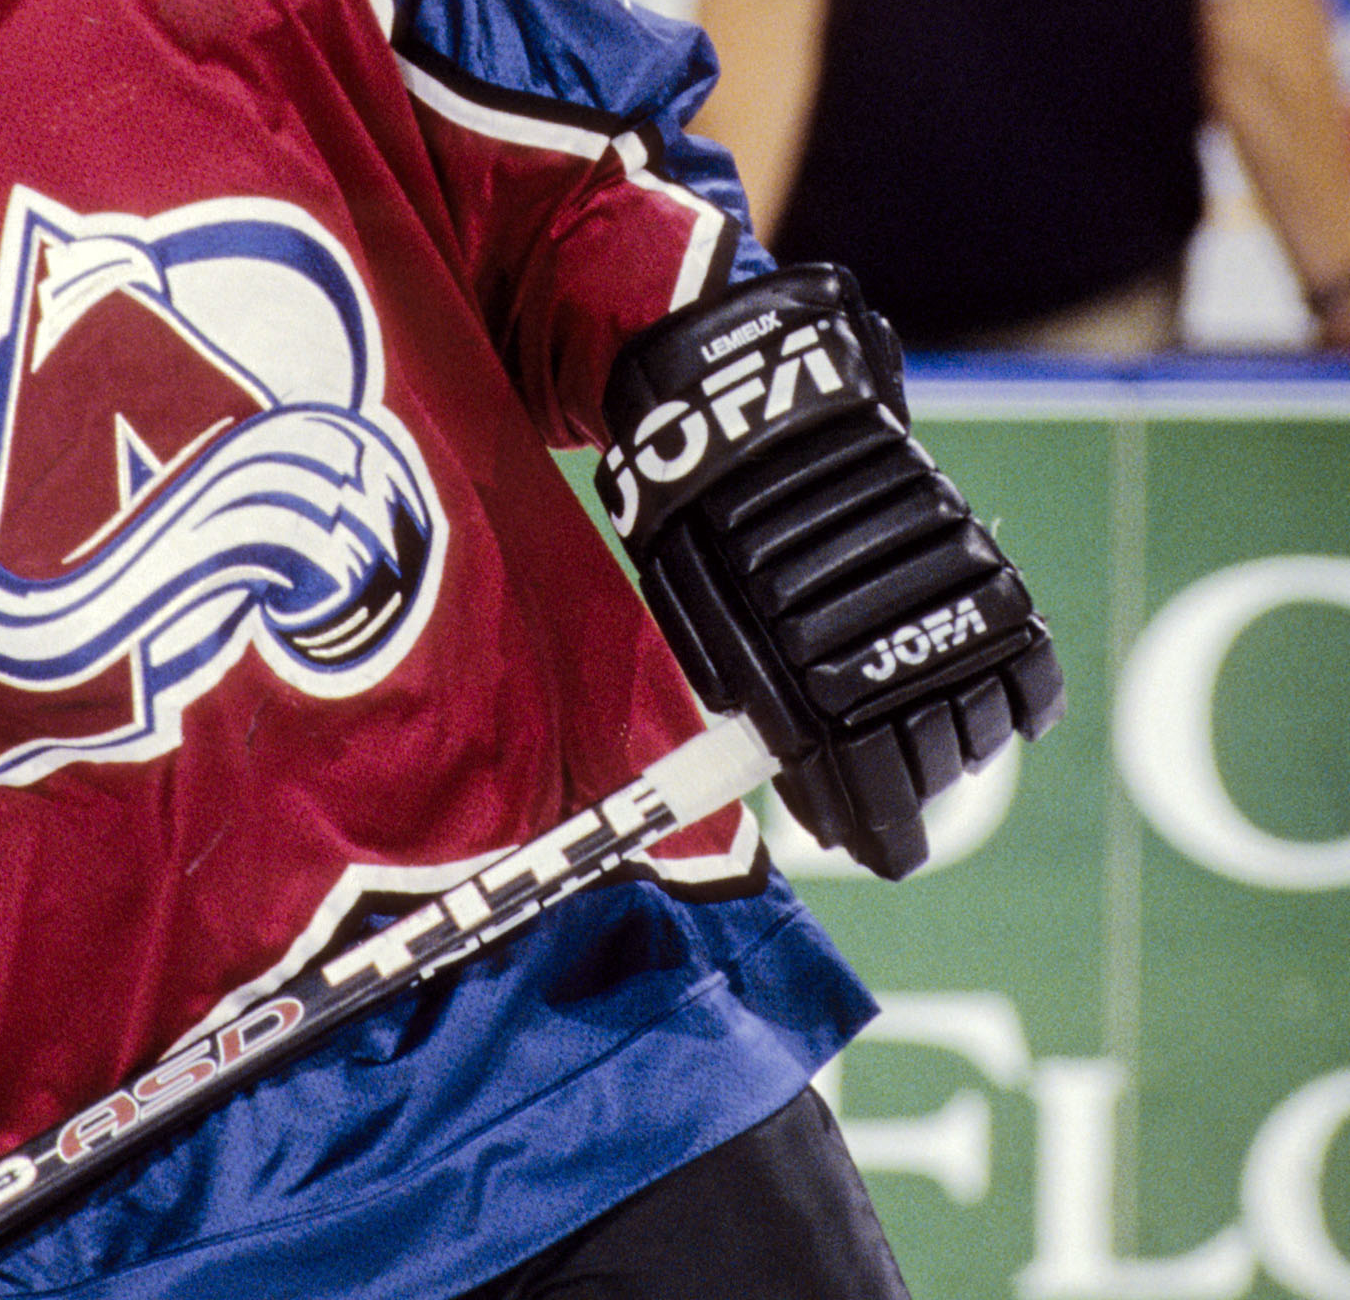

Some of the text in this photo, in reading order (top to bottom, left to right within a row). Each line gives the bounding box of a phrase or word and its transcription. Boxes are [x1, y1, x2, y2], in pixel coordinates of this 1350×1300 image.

[701, 310, 782, 363] LEMIEUX
[606, 323, 843, 538] JOFA
[861, 598, 988, 681] JOFA
[56, 996, 305, 1164] ASD
